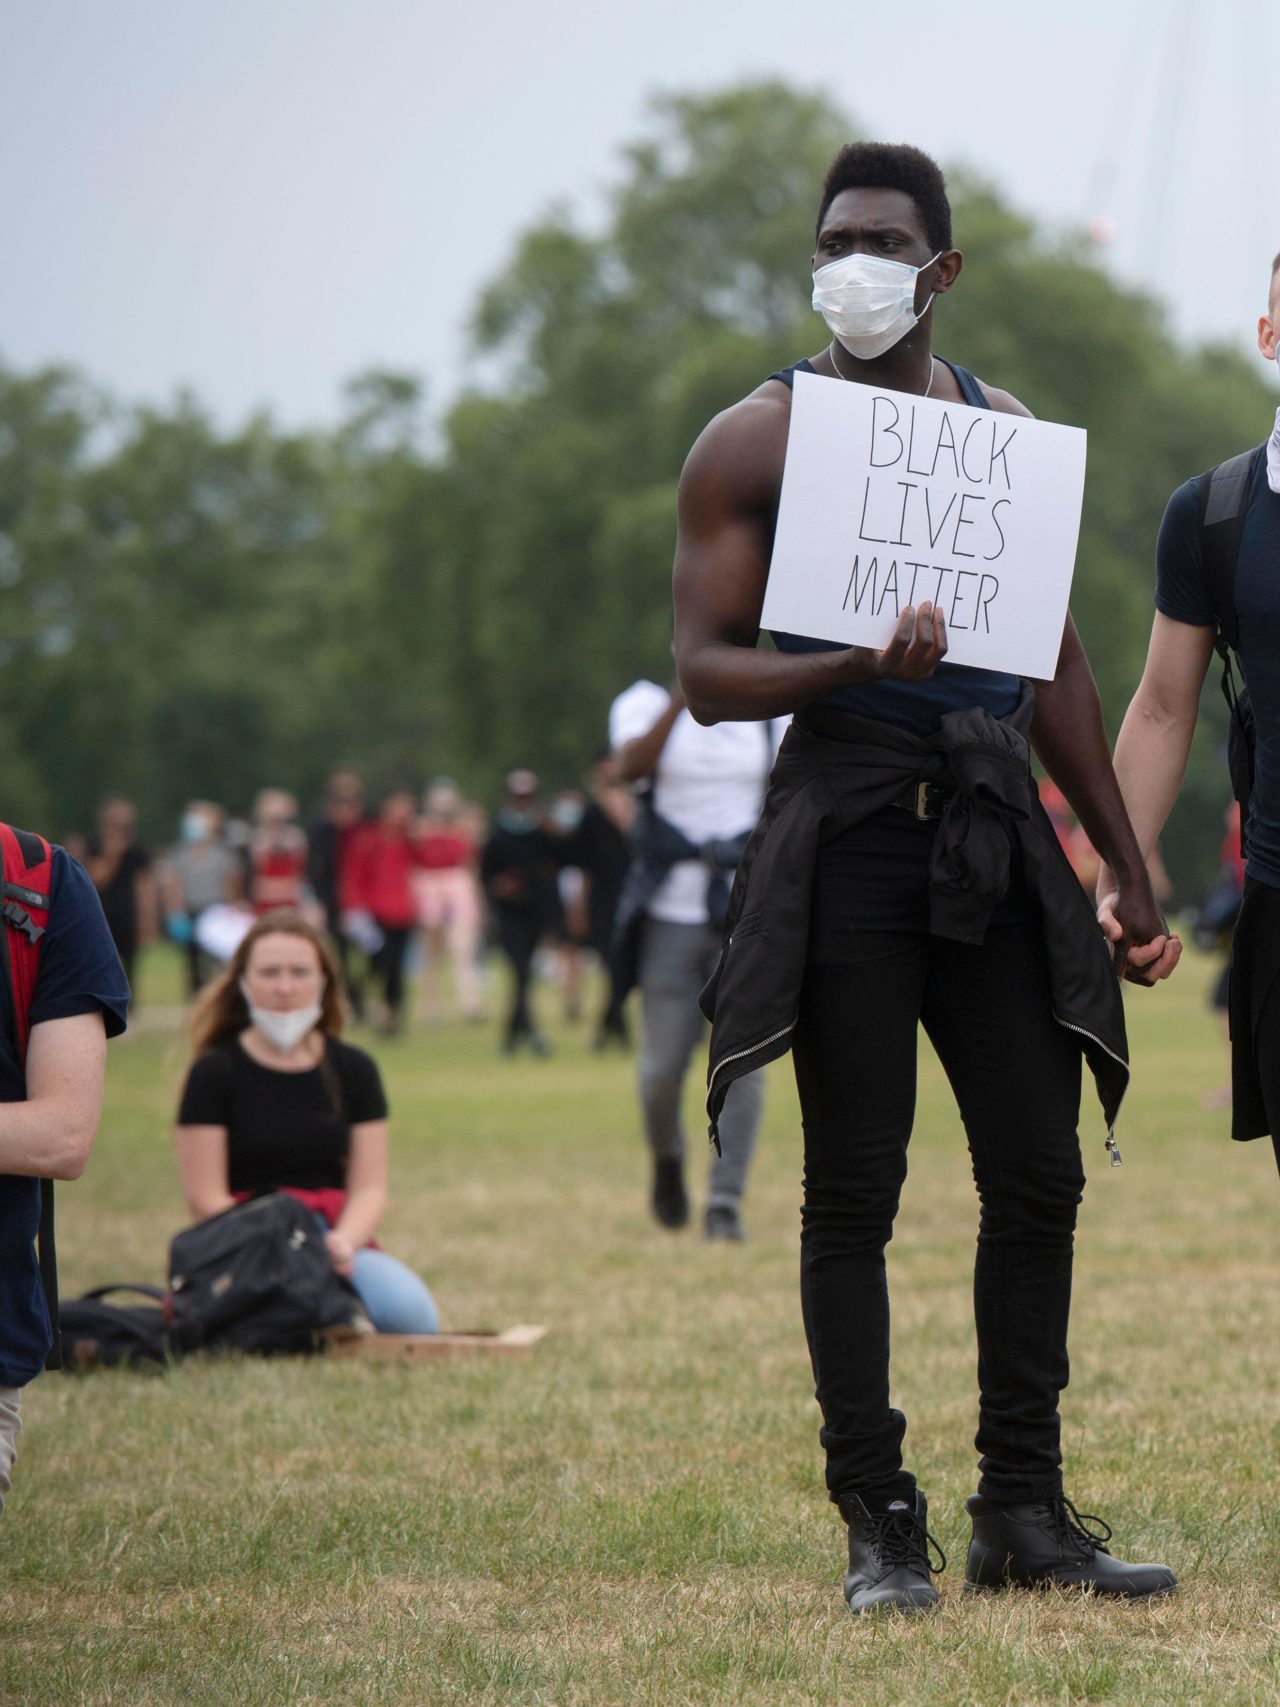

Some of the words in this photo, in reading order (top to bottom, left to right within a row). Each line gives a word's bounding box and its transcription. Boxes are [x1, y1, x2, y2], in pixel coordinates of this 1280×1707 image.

[870, 396, 1018, 490] BLACK
[858, 476, 1012, 561] LIVES
[842, 554, 1000, 634] MATTER
